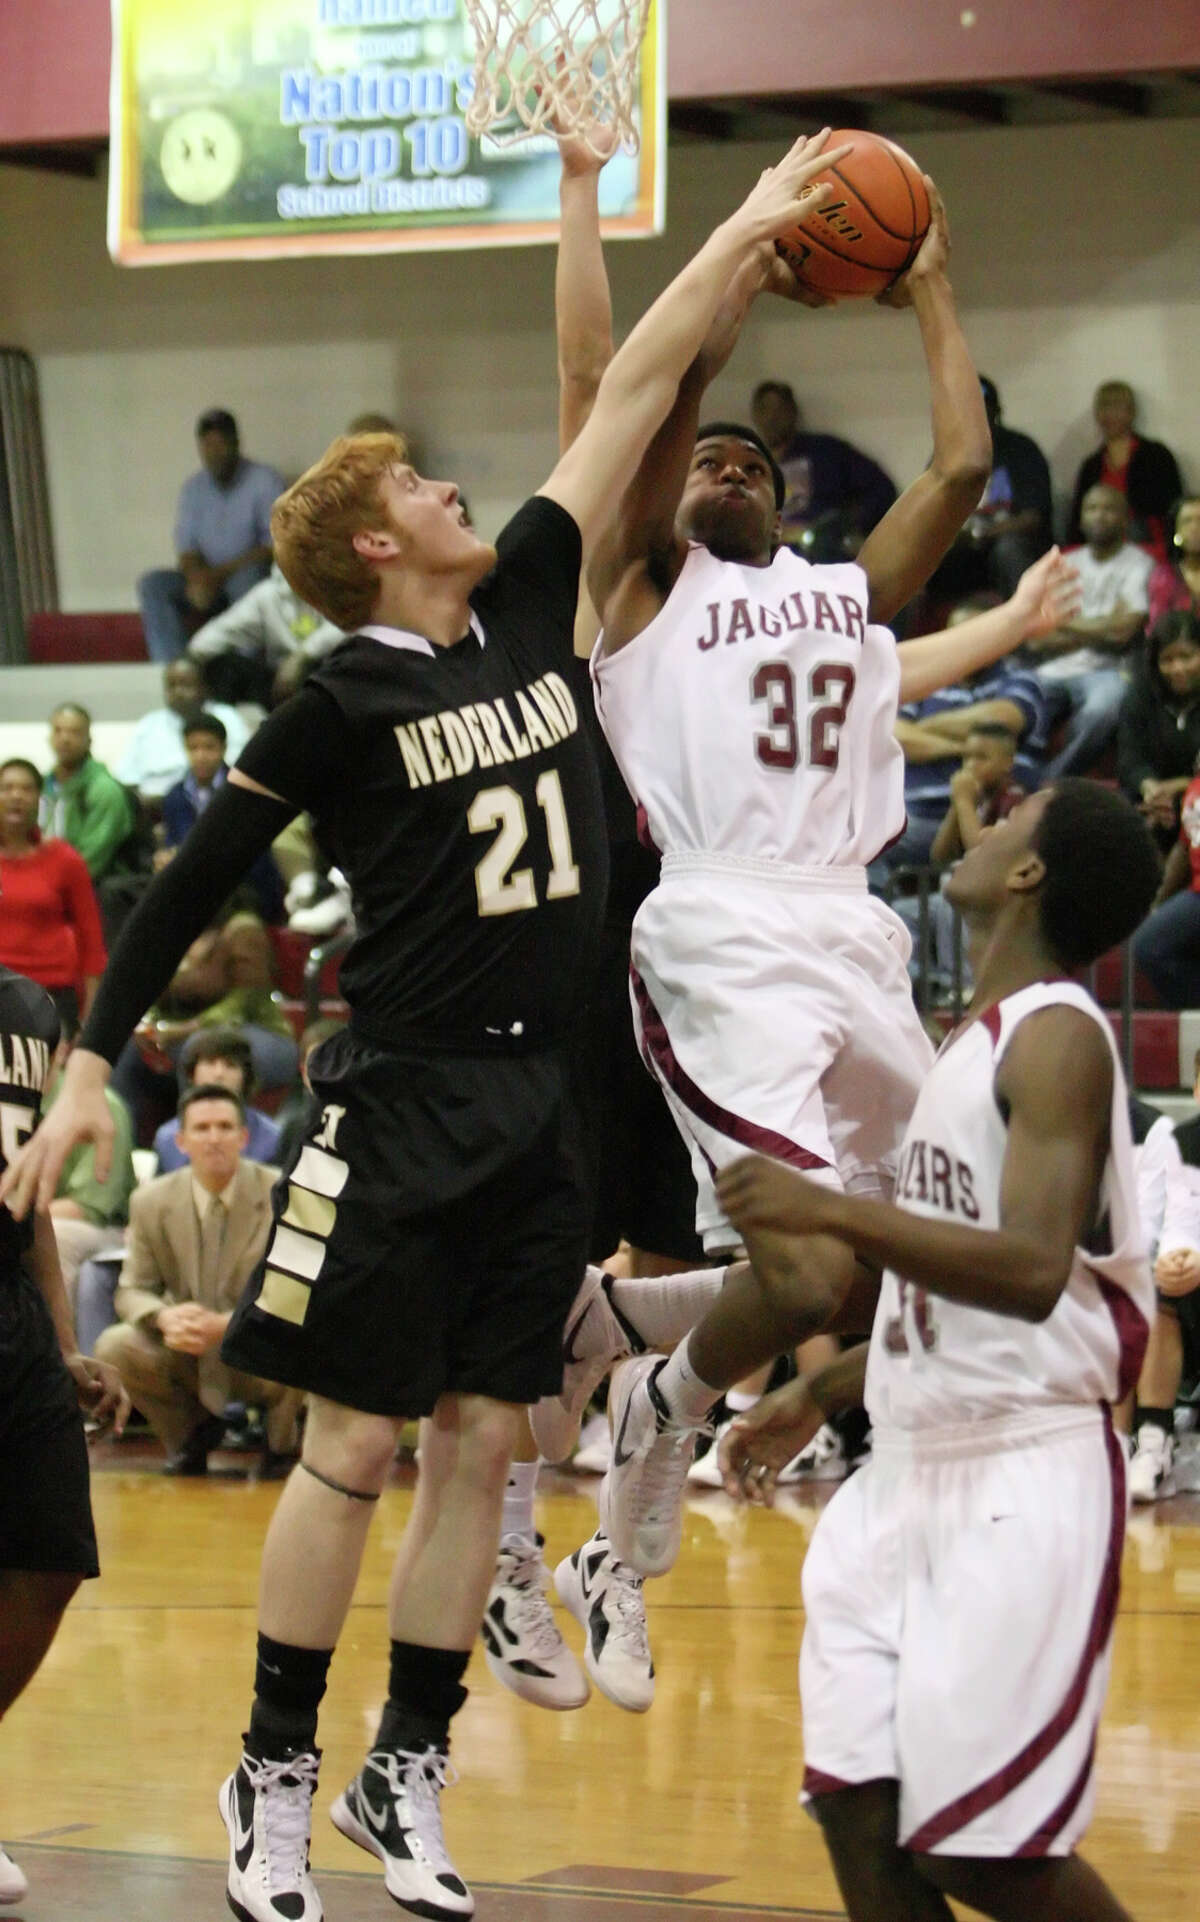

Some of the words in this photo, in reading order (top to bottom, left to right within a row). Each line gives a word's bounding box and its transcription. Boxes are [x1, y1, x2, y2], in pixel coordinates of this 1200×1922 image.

[278, 182, 371, 218] School
[299, 124, 398, 181] Top
[403, 117, 468, 176] 10
[394, 671, 578, 789] NEDERLAND
[749, 659, 857, 774] 32
[467, 769, 580, 917] 21
